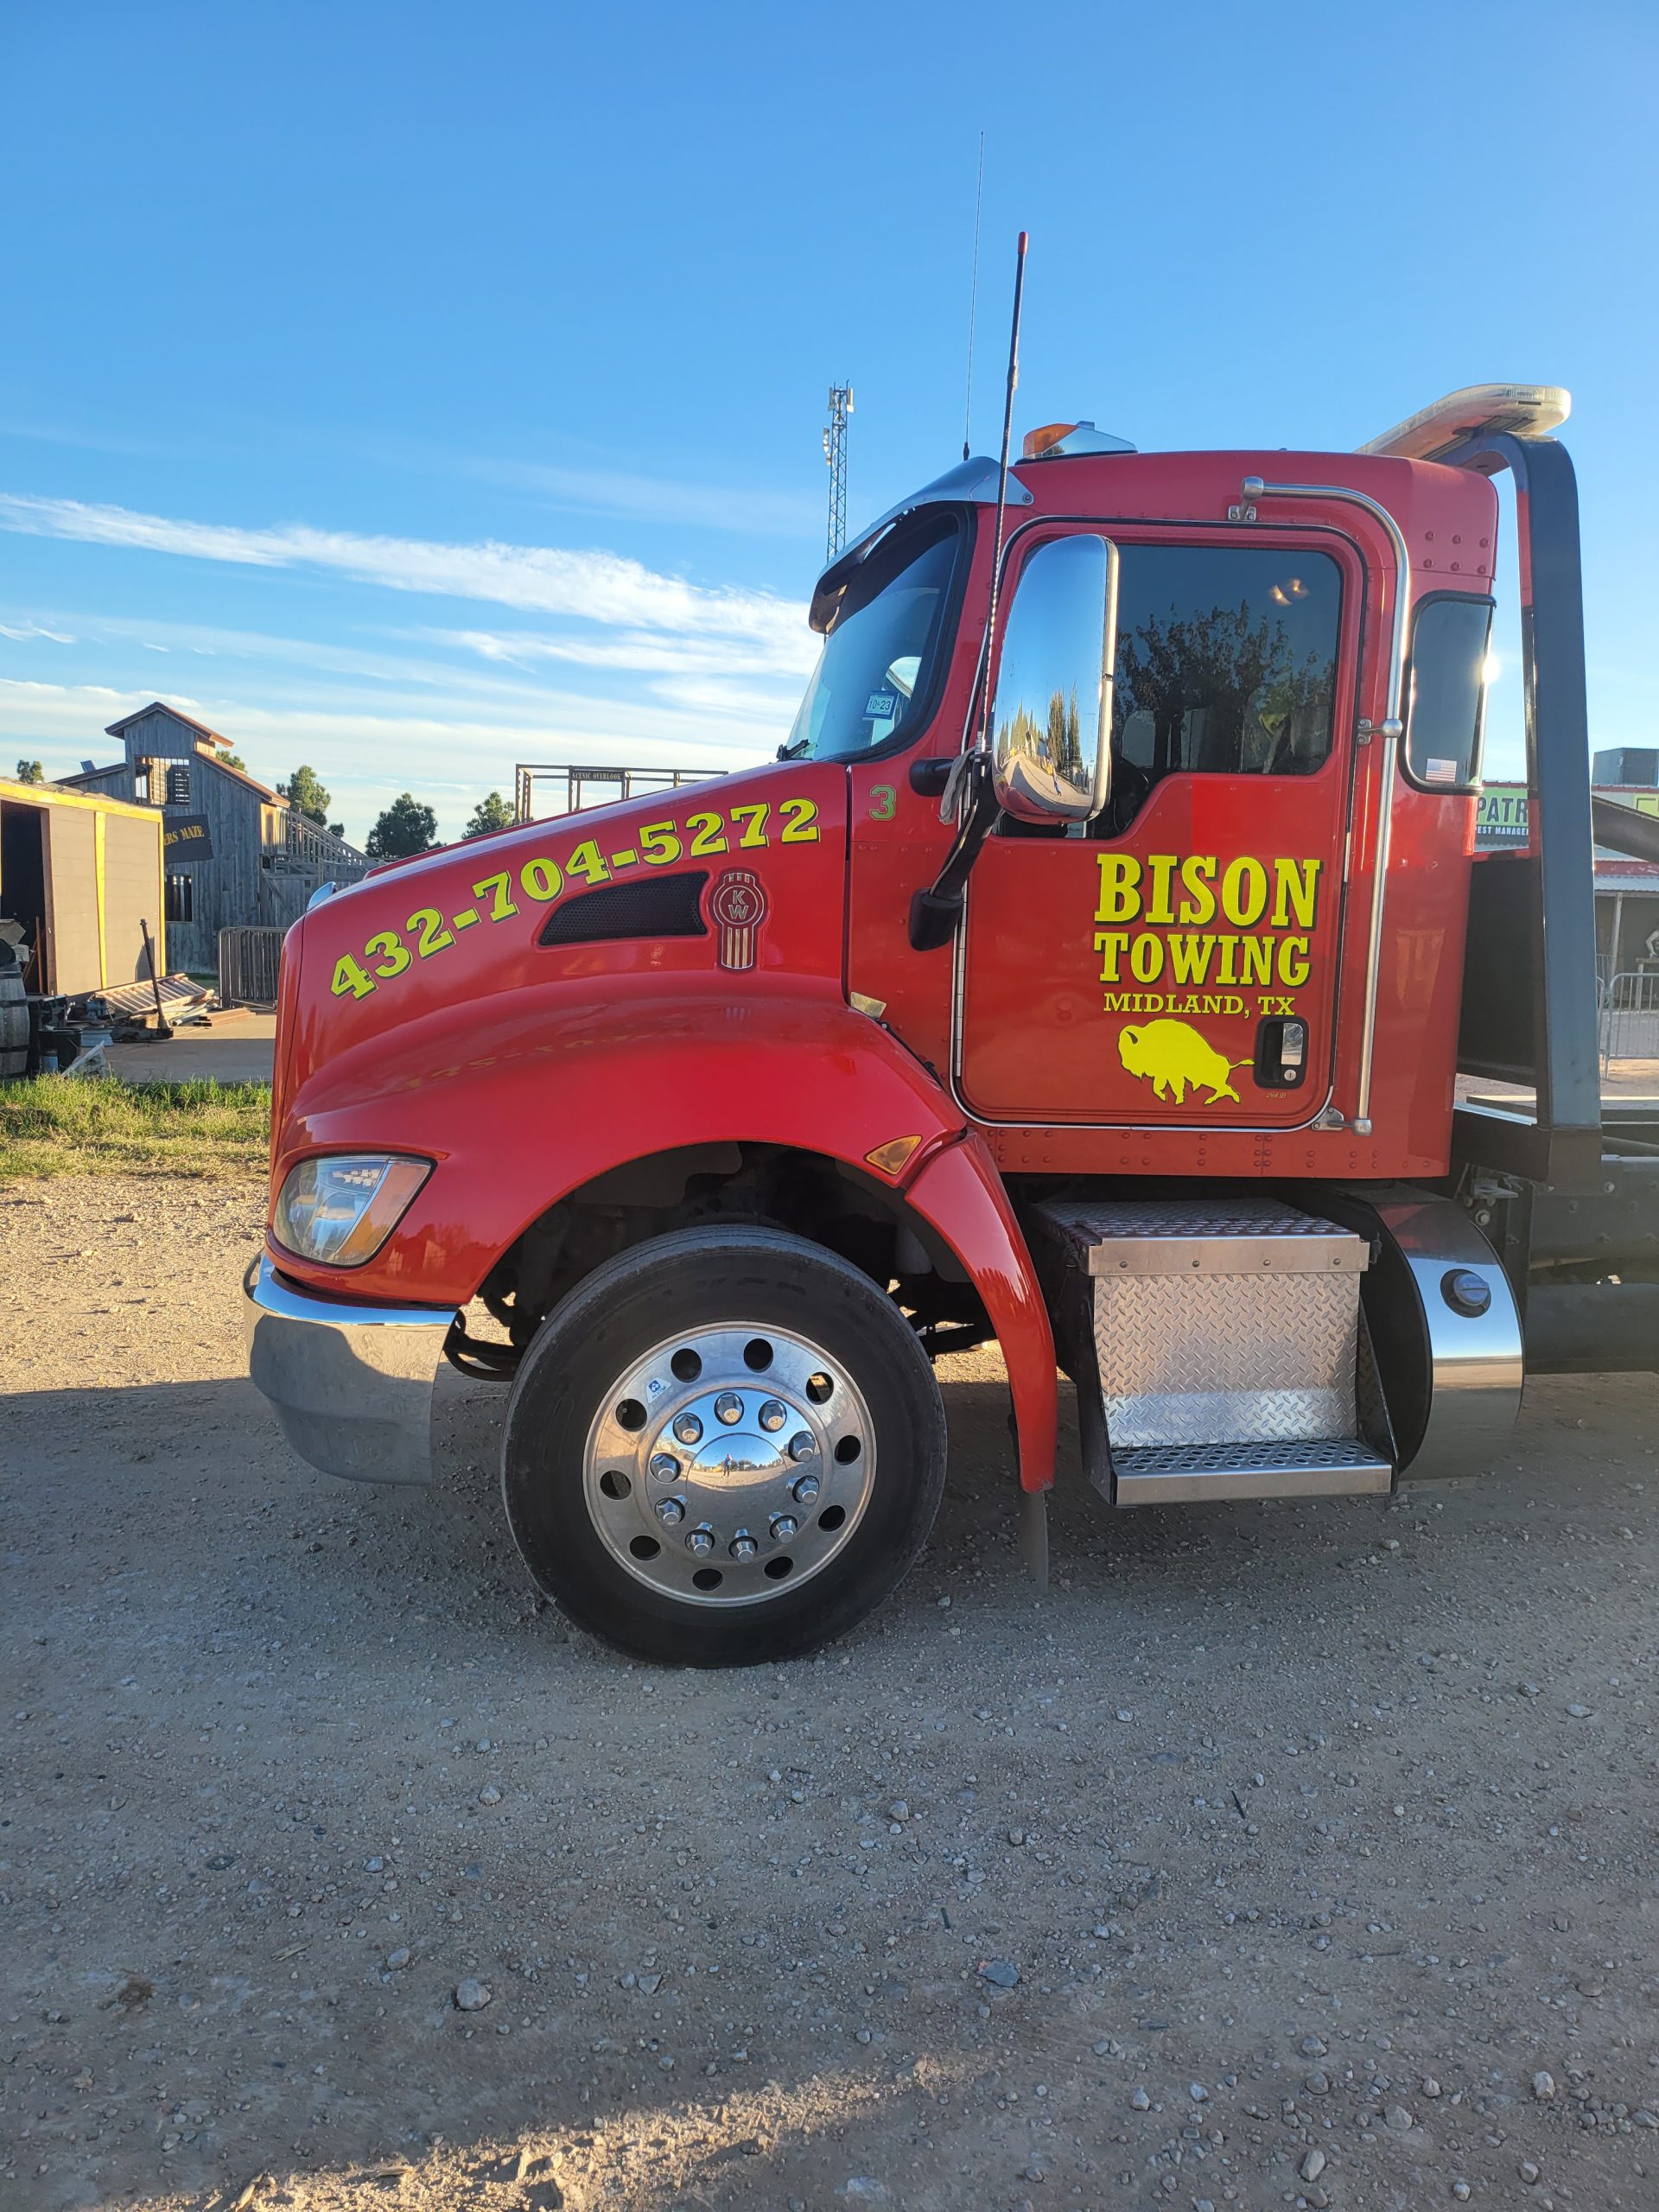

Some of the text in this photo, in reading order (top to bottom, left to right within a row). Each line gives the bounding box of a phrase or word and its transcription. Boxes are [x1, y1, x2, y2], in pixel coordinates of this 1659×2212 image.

[869, 785, 896, 821] 3
[329, 798, 822, 1001] 432-704-5272
[1094, 854, 1322, 929] BISON
[1094, 932, 1313, 988] TOWING
[1103, 993, 1296, 1019] MIDLAND, TX
